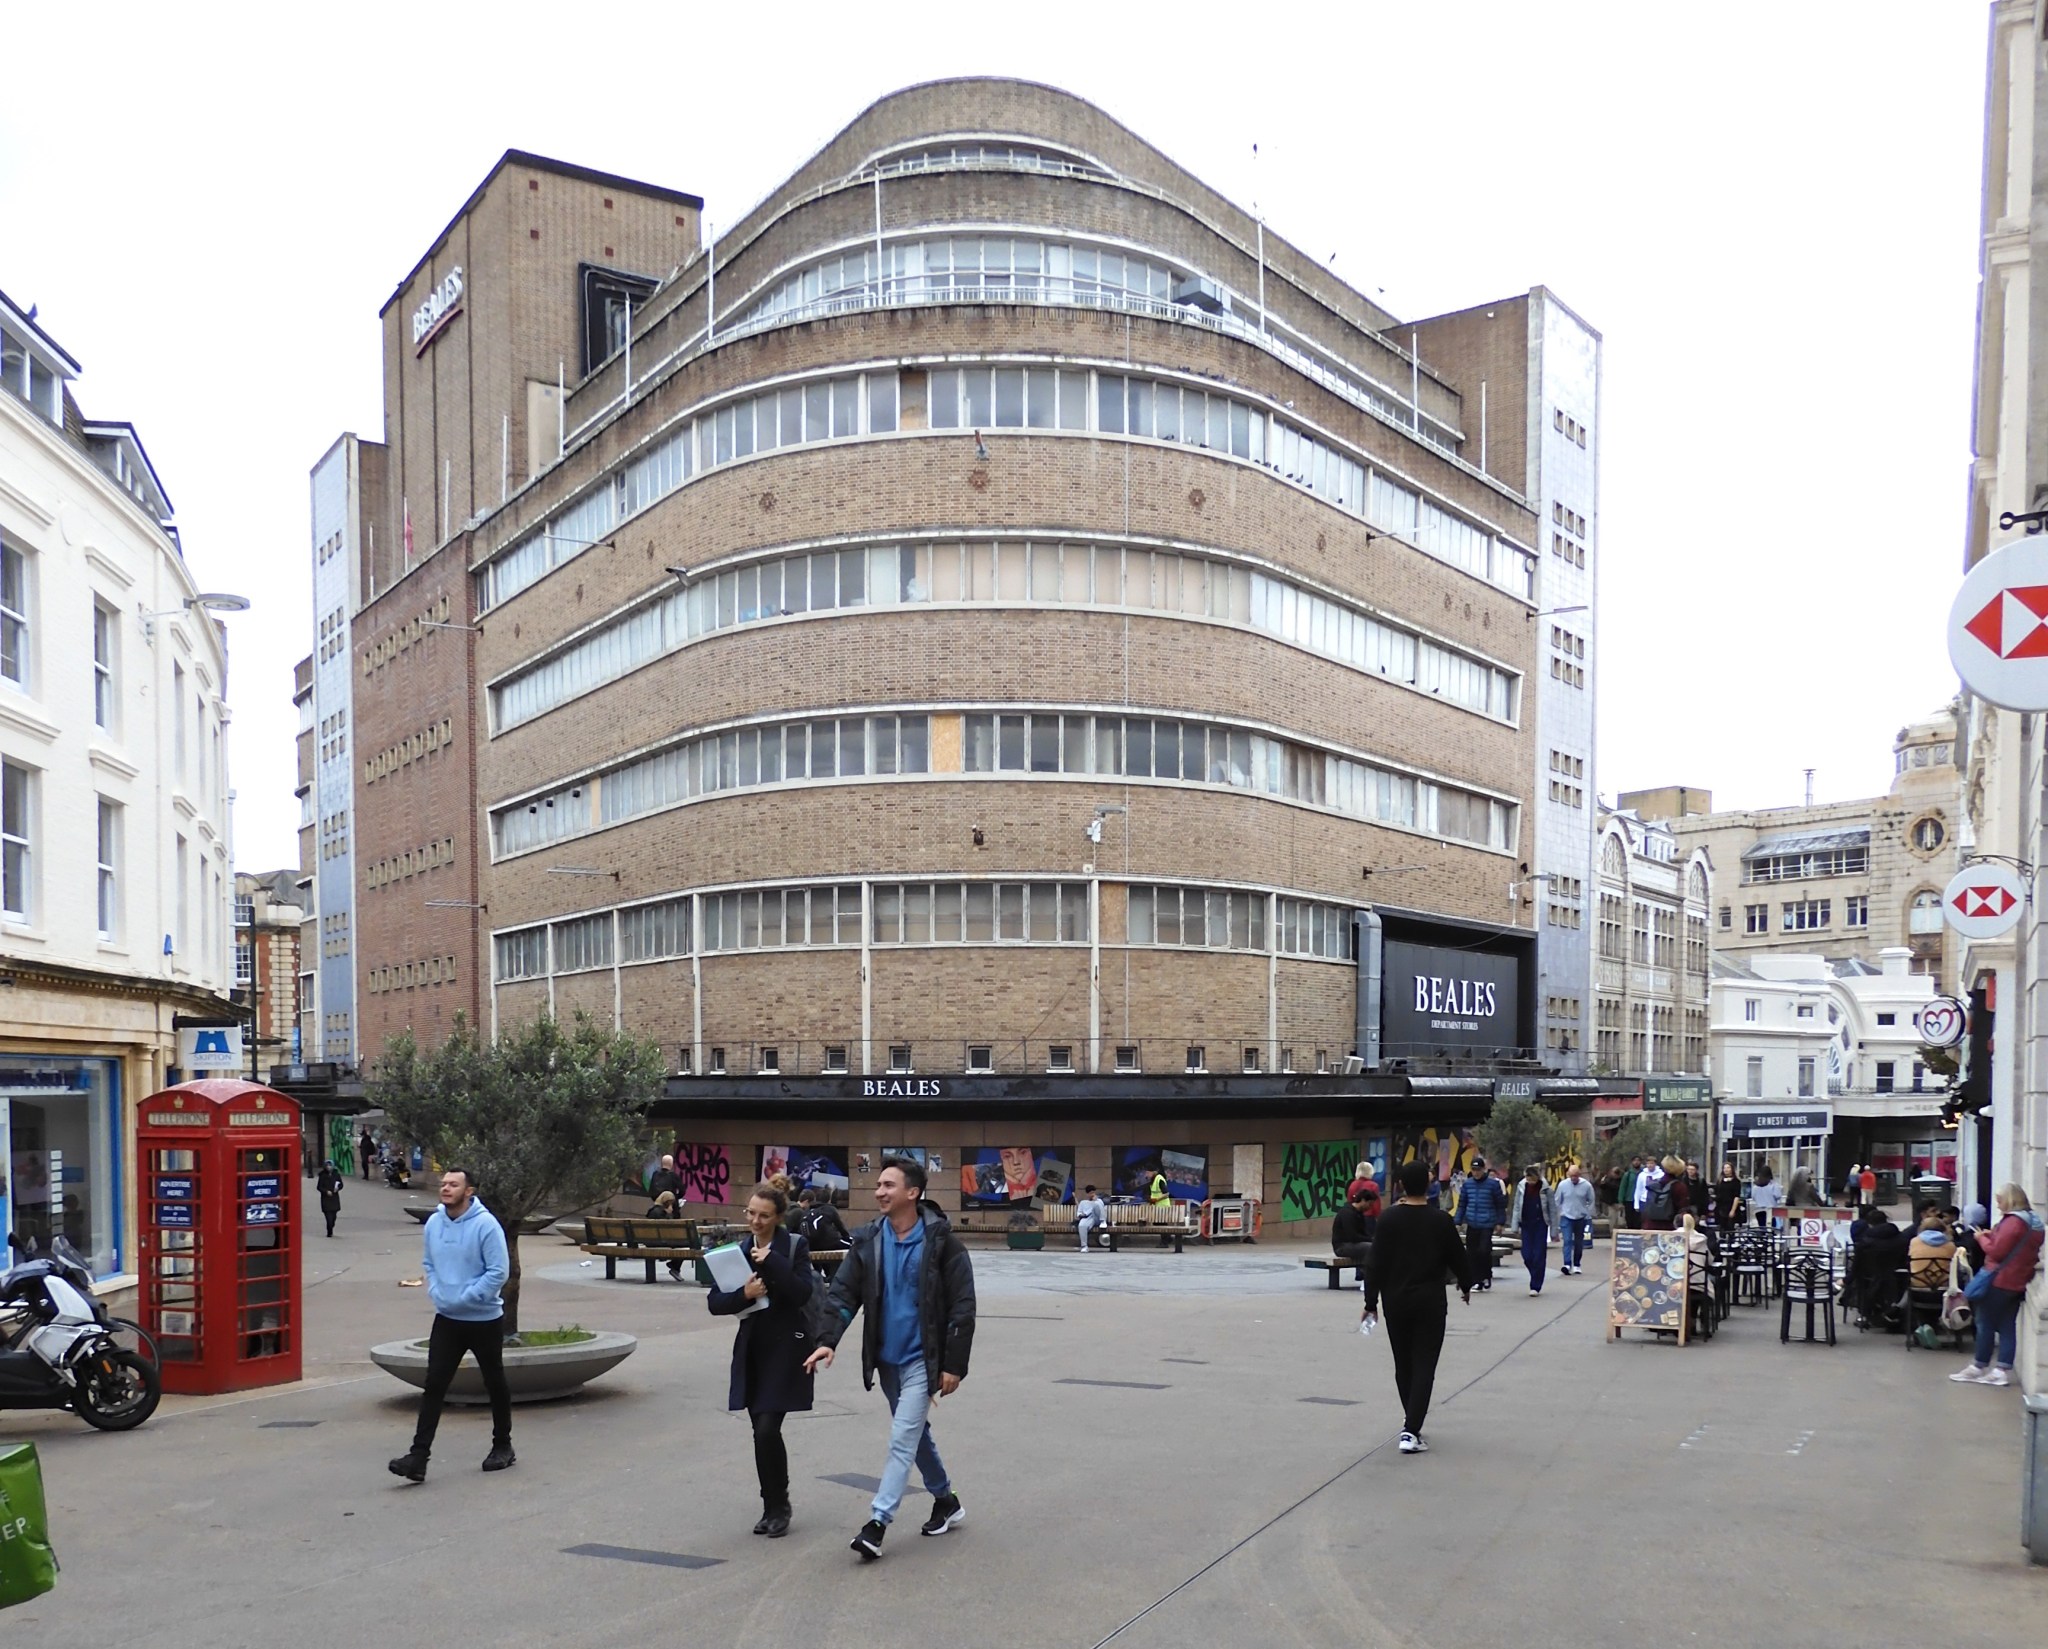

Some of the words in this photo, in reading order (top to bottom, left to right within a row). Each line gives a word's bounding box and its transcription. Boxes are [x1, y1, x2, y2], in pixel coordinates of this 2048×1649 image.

[1414, 975, 1496, 1017] BEALES
[1431, 1019, 1462, 1030] DEPARTMENT
[1462, 1021, 1479, 1031] STORES
[193, 1053, 232, 1062] SKIPTON
[863, 1080, 941, 1096] BEALES
[1500, 1082, 1531, 1096] BEALES
[151, 1113, 209, 1124] TELEPHONE
[232, 1113, 286, 1124] TELEPHONE
[1757, 1117, 1784, 1126] ERNEST
[1787, 1116, 1808, 1125] JONES
[1282, 1175, 1350, 1219] TURE
